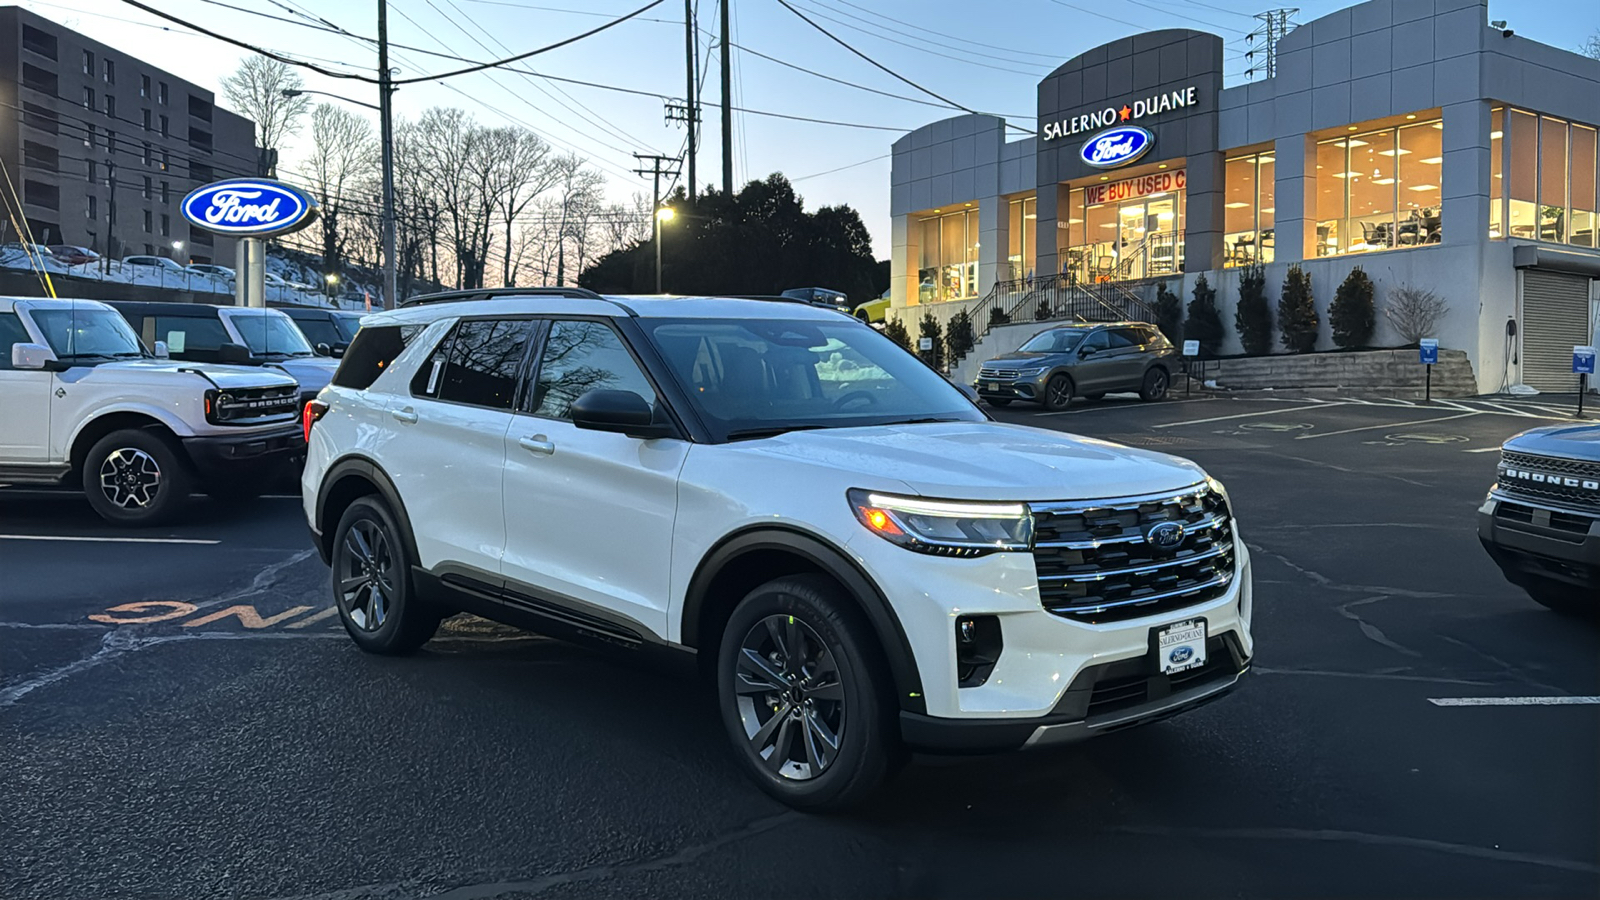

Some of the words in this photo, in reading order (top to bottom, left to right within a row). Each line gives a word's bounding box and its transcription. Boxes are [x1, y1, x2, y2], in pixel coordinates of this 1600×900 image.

[1043, 107, 1117, 141] SALERNO
[1133, 86, 1197, 119] DUANE
[1092, 134, 1135, 162] Ford
[1086, 186, 1105, 204] WE
[1108, 180, 1134, 201] BUY
[1137, 173, 1172, 195] USED
[1175, 170, 1186, 188] C
[205, 190, 282, 223] Ford
[249, 398, 294, 408] BRONCO
[1506, 469, 1599, 490] BRONCO
[1173, 648, 1189, 662] Ford
